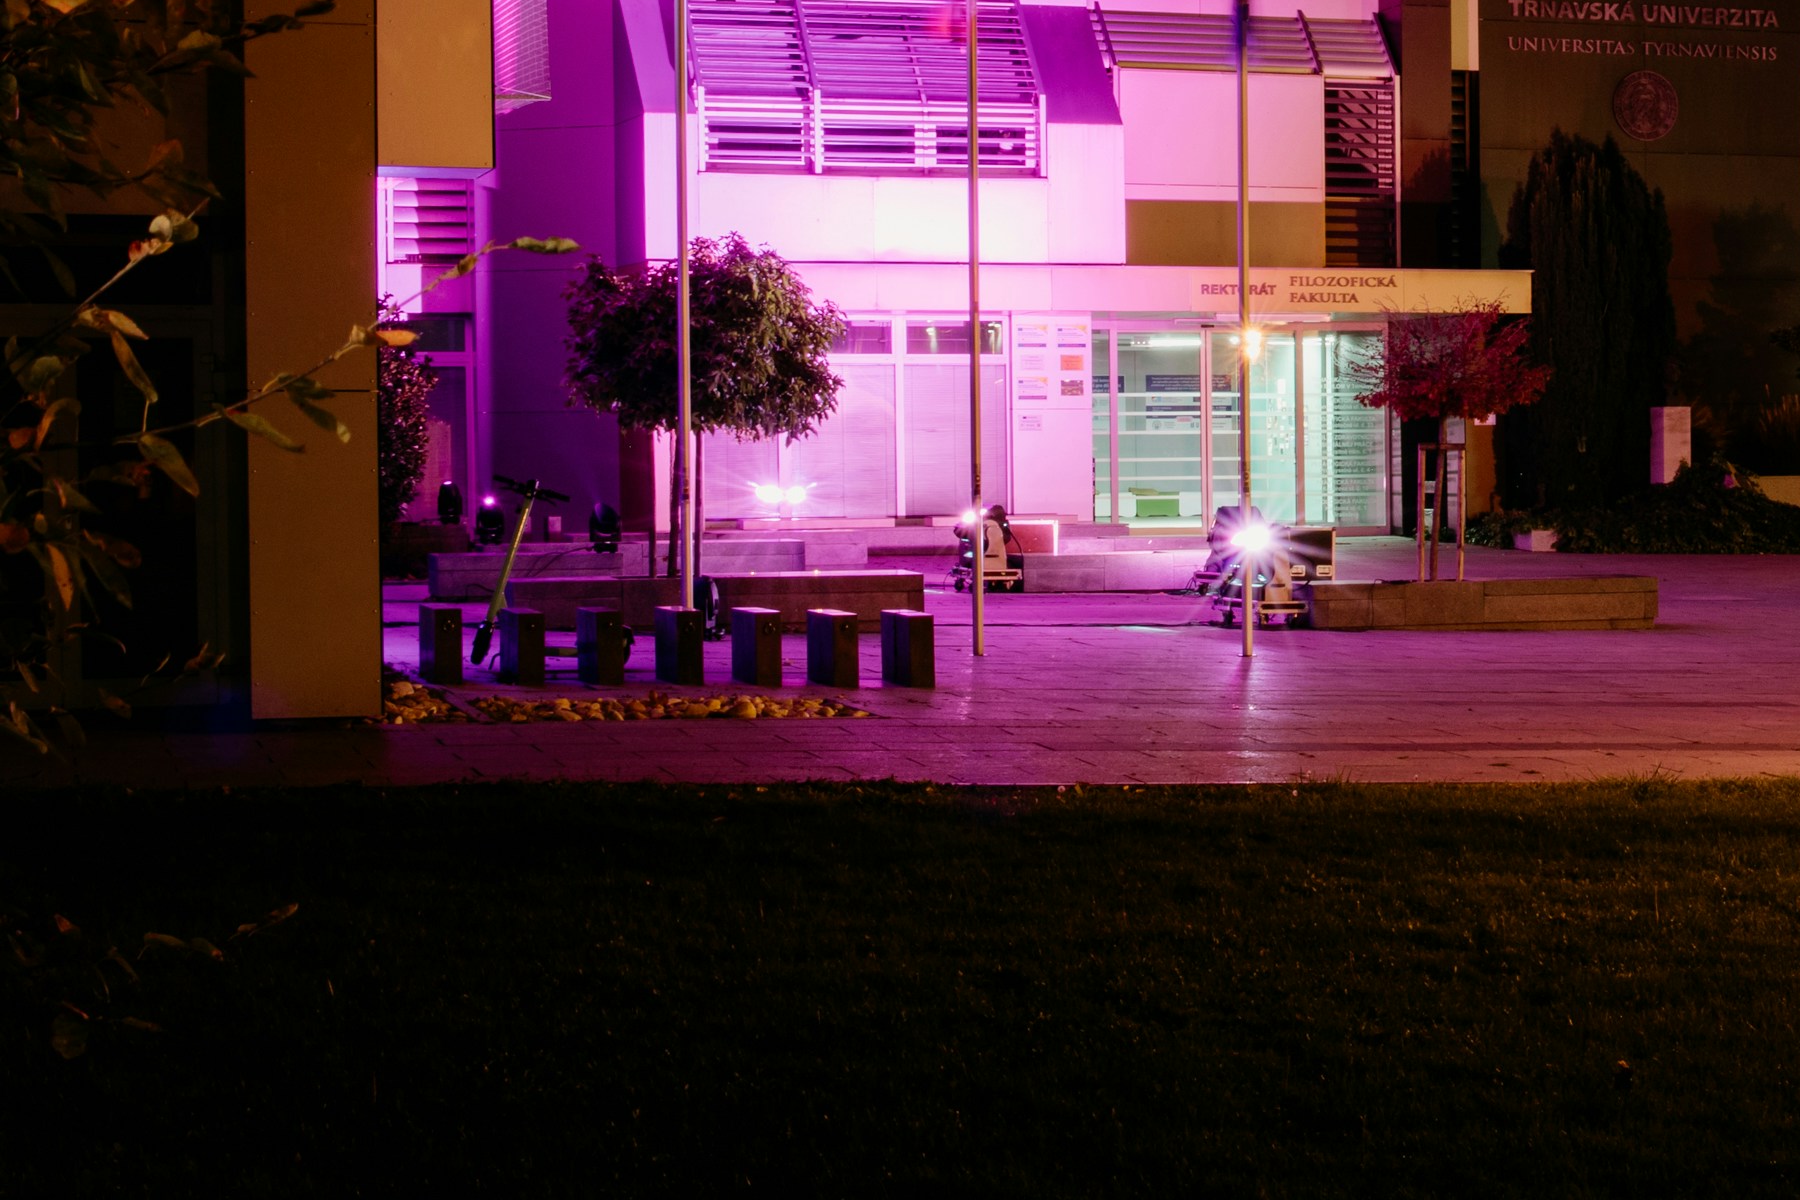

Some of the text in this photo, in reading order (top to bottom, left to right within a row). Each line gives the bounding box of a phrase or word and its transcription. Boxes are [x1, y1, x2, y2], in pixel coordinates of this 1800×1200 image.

[1508, 0, 1779, 28] TRNAVSKÁ UNIVERZITA
[1508, 36, 1777, 61] UNIVERSITAS TYRNAVIENSIS
[1289, 275, 1397, 288] FILOZOFICKÁ
[1201, 282, 1276, 295] REKTRÁT
[1289, 293, 1360, 303] FAKULTA
